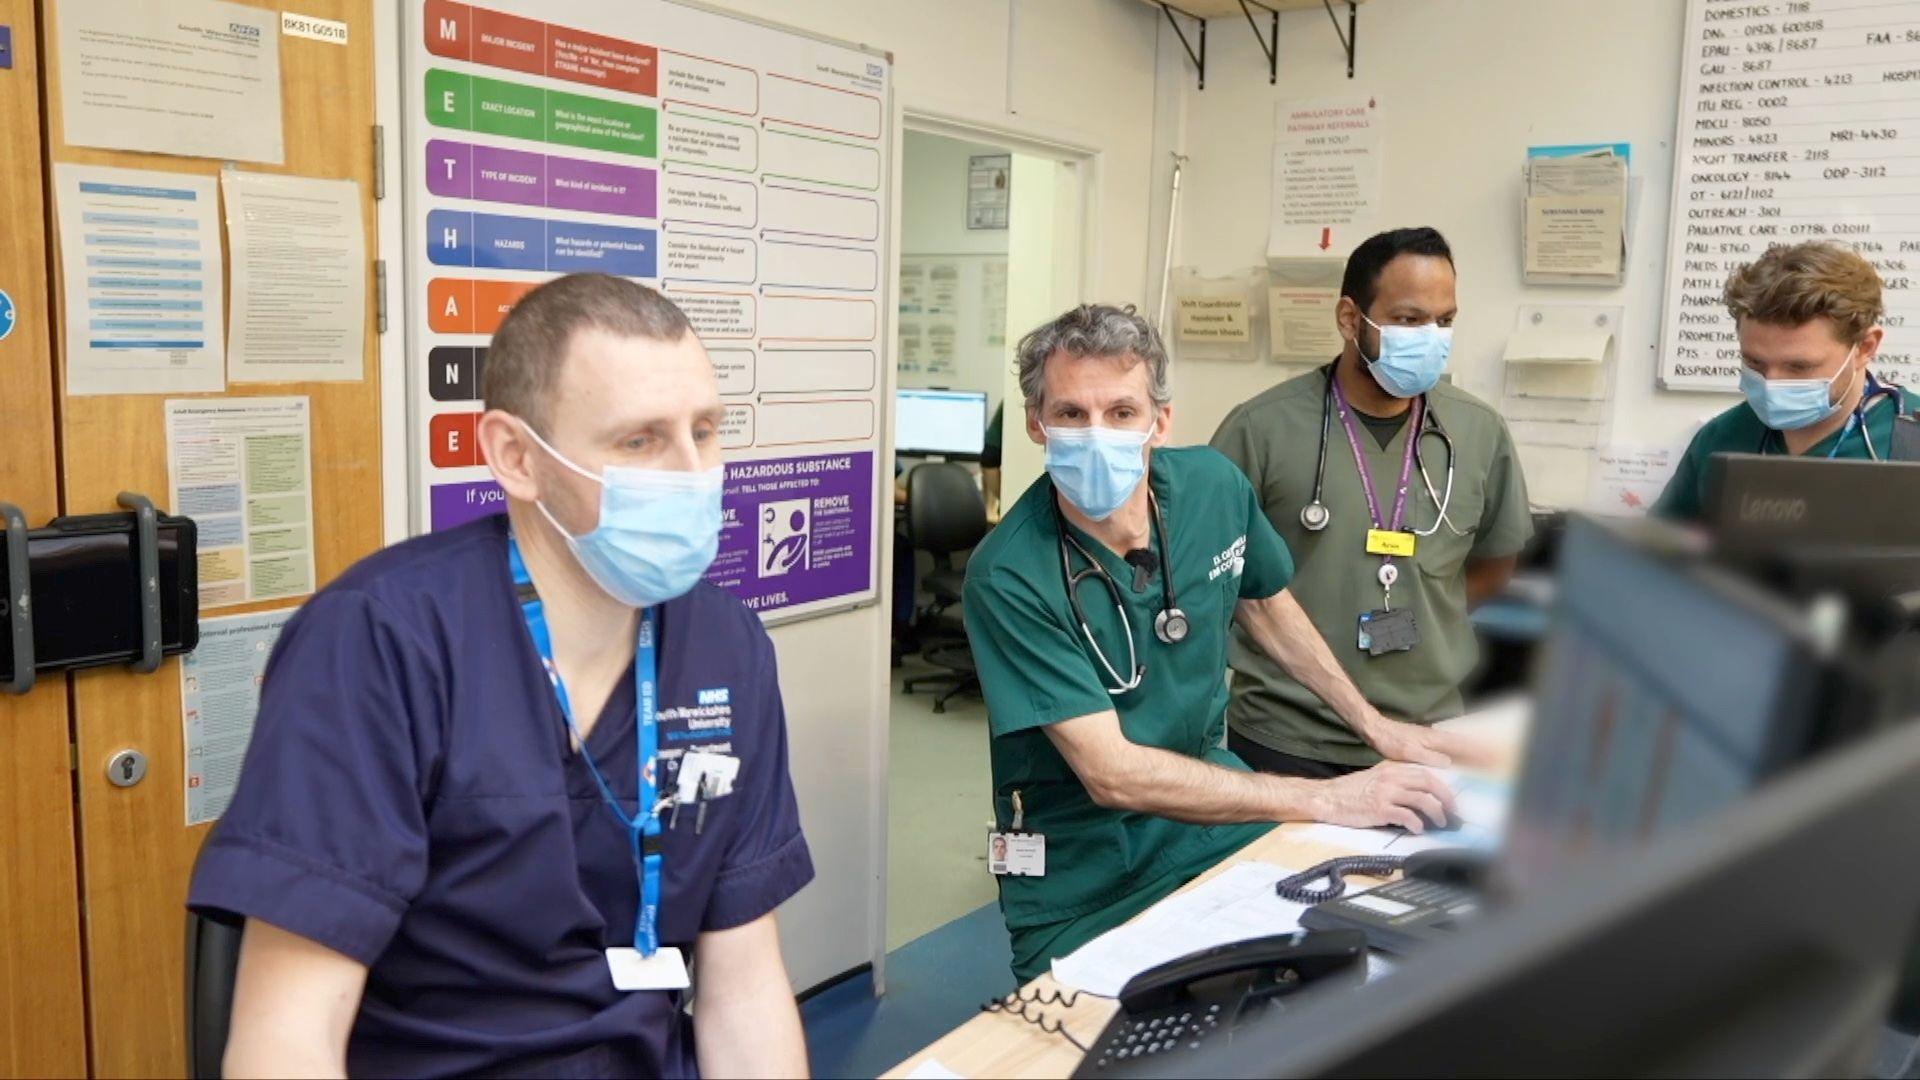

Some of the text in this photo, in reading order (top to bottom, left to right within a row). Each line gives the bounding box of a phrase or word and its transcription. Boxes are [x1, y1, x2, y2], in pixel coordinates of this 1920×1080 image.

[1704, 6, 1770, 22] DOMESTICS
[440, 17, 457, 42] M
[481, 33, 536, 53] MAJOR INCIDENT
[1866, 31, 1891, 45] FAA
[1700, 79, 1753, 94] INFECTION
[1758, 77, 1809, 91] CONTROL
[443, 91, 455, 113] E
[481, 100, 536, 118] EXACT LOCATION
[1719, 99, 1743, 111] REG
[1693, 135, 1735, 147] MINORS
[1733, 151, 1788, 164] TRANSFER
[443, 158, 457, 180] T
[481, 169, 537, 185] TYPE OF INCIDENT
[1691, 171, 1750, 184] ONCOLOGY
[1690, 190, 1705, 201] OT
[1688, 207, 1746, 218] OUTREACH
[1749, 224, 1777, 236] CARE
[444, 227, 458, 249] H
[494, 238, 526, 250] HAZARDS
[1683, 278, 1711, 289] PATH
[444, 296, 459, 317] A
[1680, 312, 1719, 324] PHYSIO
[1679, 330, 1736, 342] PROMETHE
[445, 363, 459, 385] N
[448, 431, 459, 452] E
[730, 457, 851, 481] HAZARDOUS SUBSTANCE
[741, 483, 757, 494] TELL
[758, 482, 778, 492] THOSE
[779, 479, 809, 491] AFFECTED
[466, 489, 505, 504] If you
[813, 495, 849, 510] REMOVE
[1739, 491, 1806, 520] Lenovo
[761, 592, 789, 607] LIVES.
[698, 687, 729, 705] NHS
[642, 696, 653, 727] TEAM
